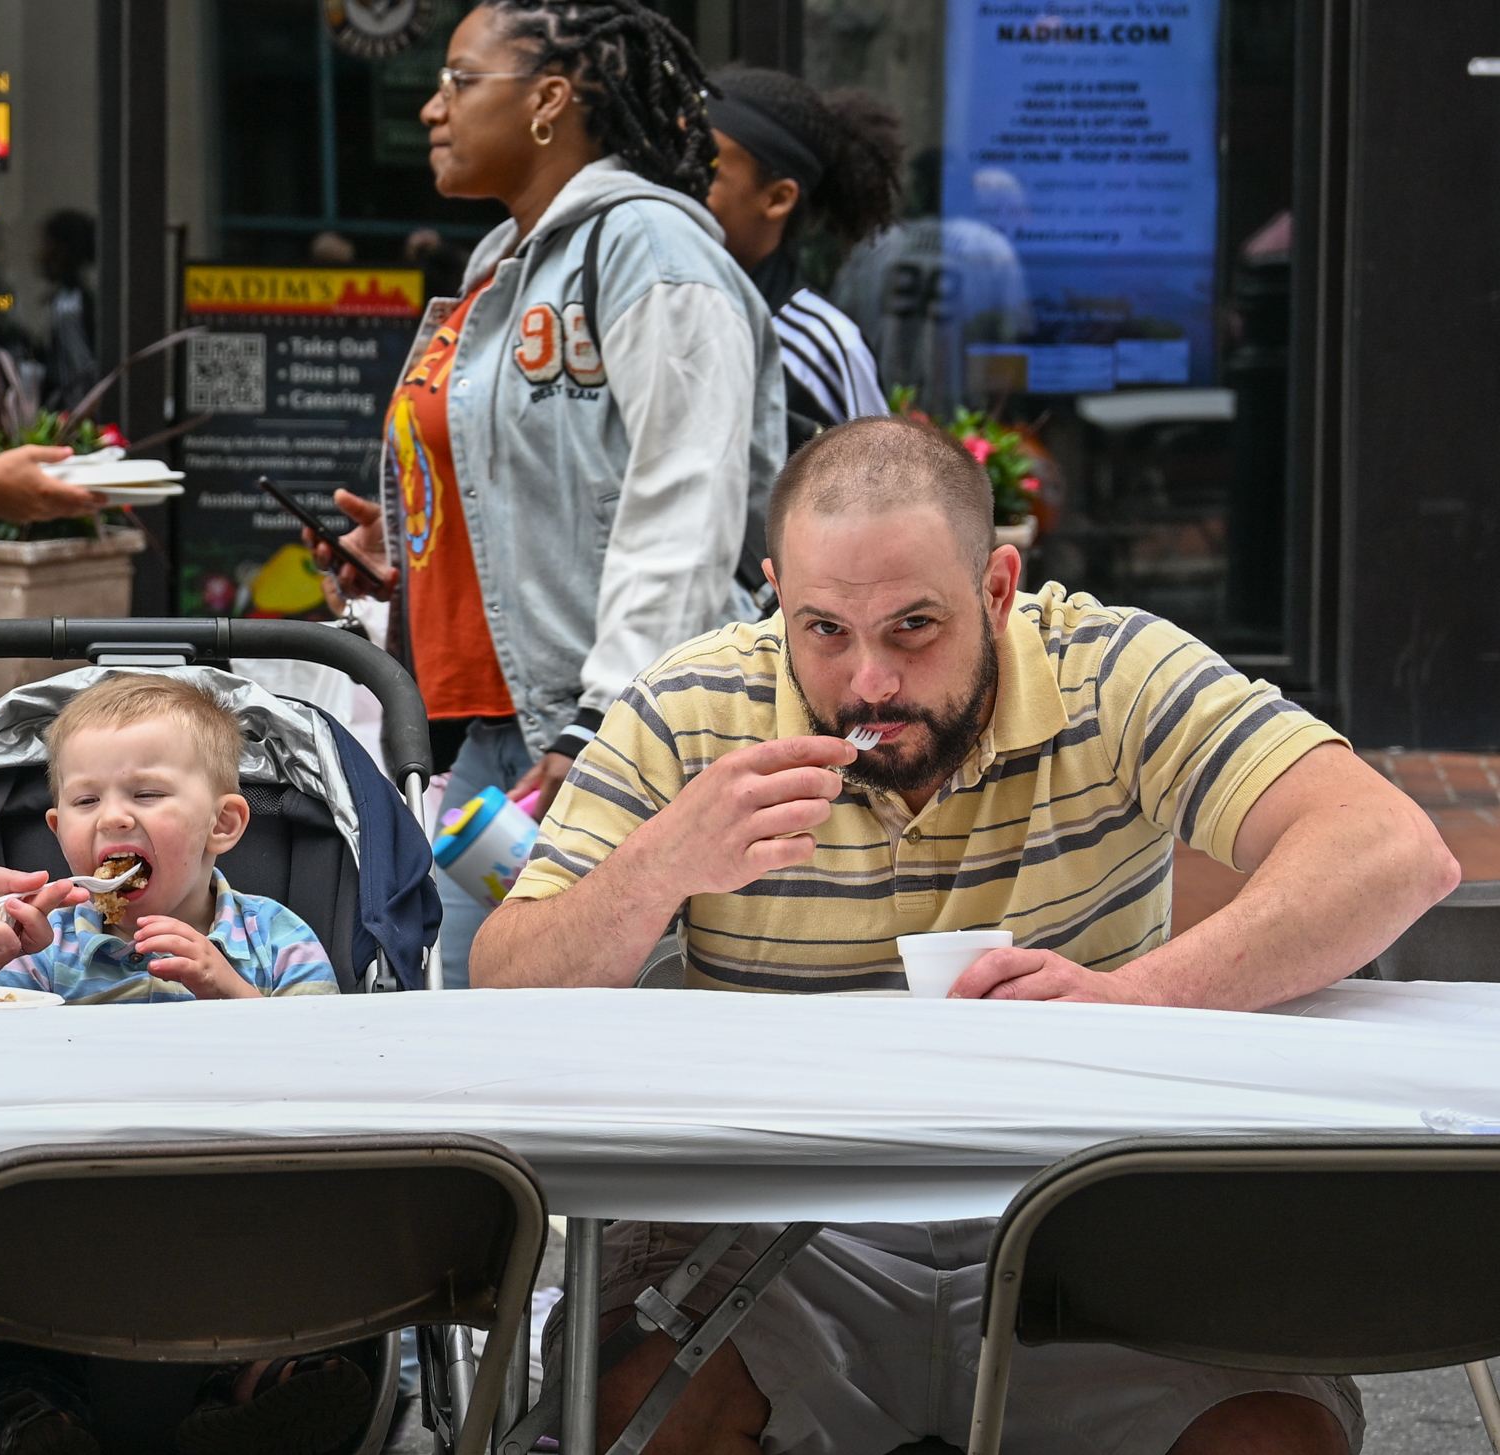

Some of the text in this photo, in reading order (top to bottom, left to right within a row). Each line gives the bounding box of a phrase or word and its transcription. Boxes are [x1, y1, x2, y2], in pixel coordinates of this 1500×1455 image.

[998, 23, 1171, 44] NADIMS.COM
[191, 274, 335, 300] NADIM'S
[291, 335, 378, 358] Take Out
[290, 362, 360, 384] Dine In
[290, 388, 375, 415] Catering
